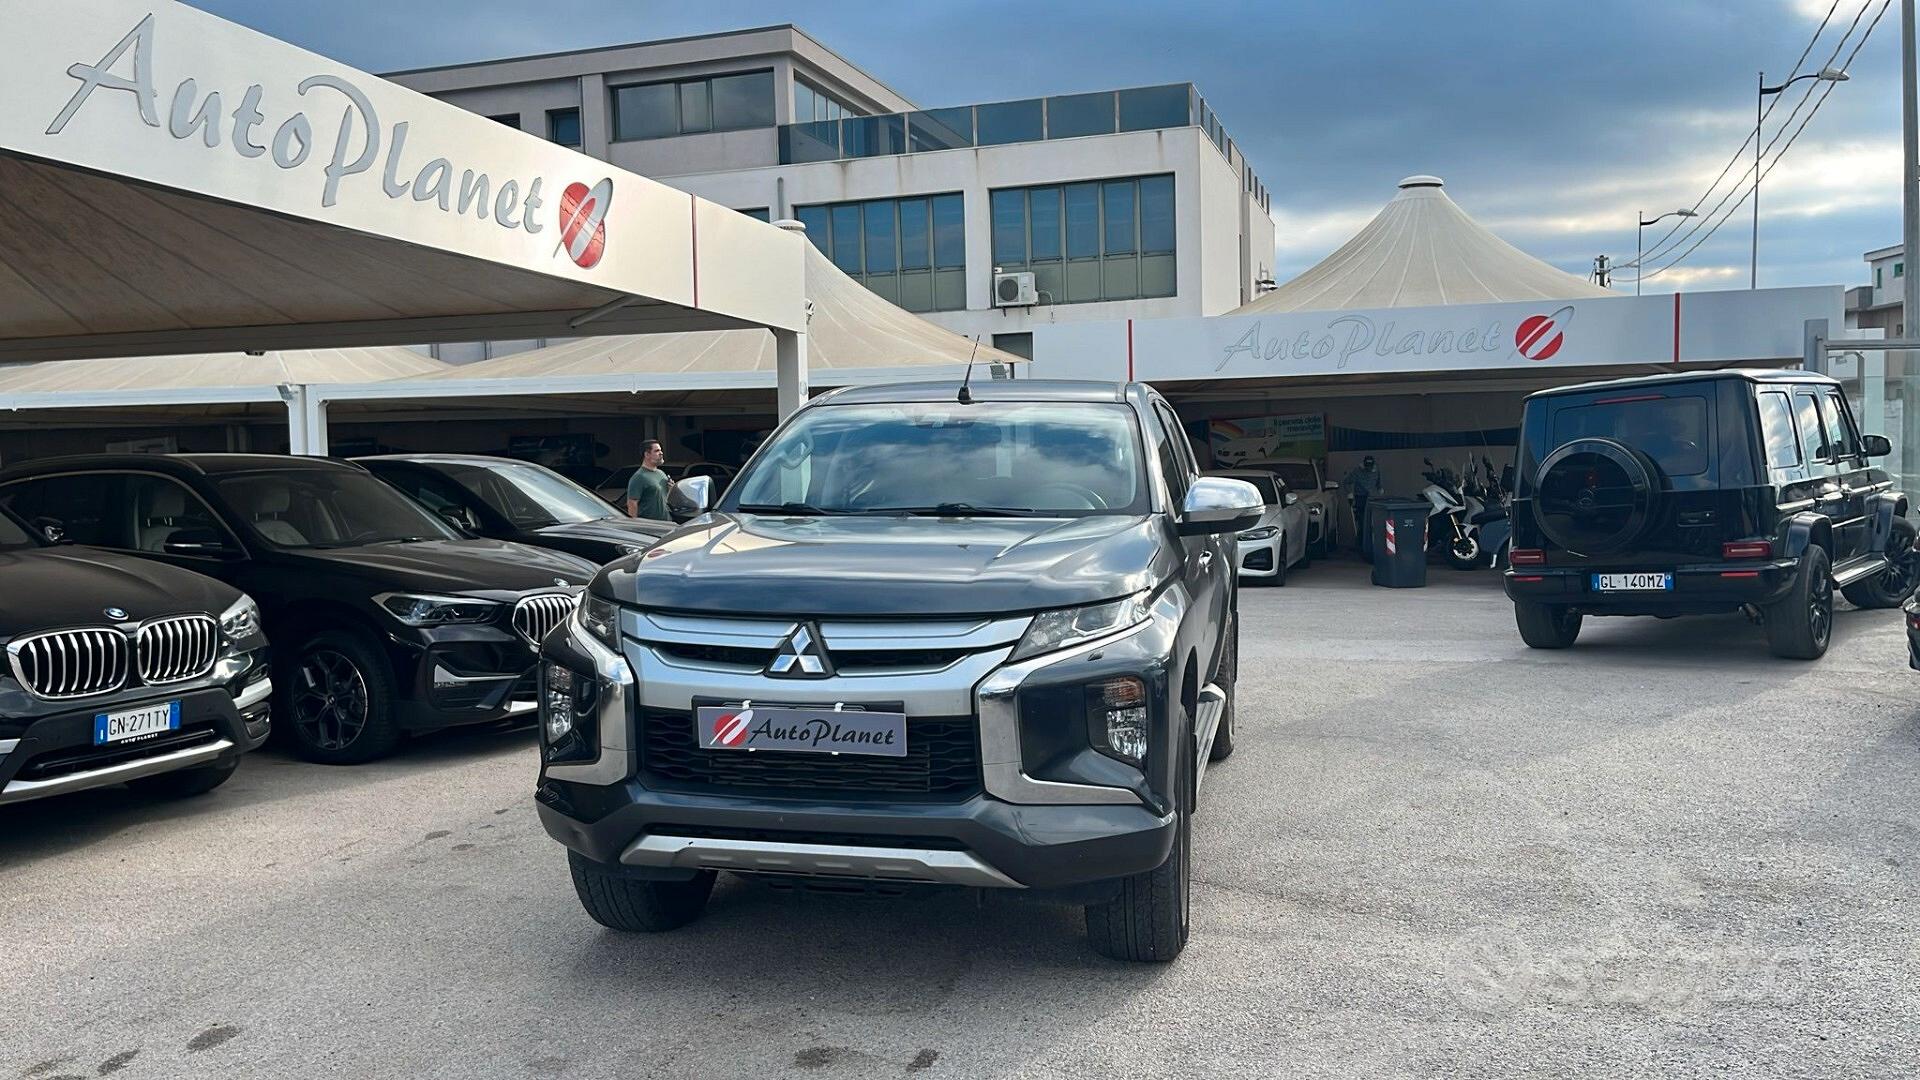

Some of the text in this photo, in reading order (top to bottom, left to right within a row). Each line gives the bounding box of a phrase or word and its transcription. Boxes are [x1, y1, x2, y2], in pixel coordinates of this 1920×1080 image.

[45, 12, 543, 233] AutoPlanet
[1215, 314, 1503, 372] AutoPlanet
[1624, 575, 1663, 588] 140MZ
[748, 718, 895, 747] AutoPlanet
